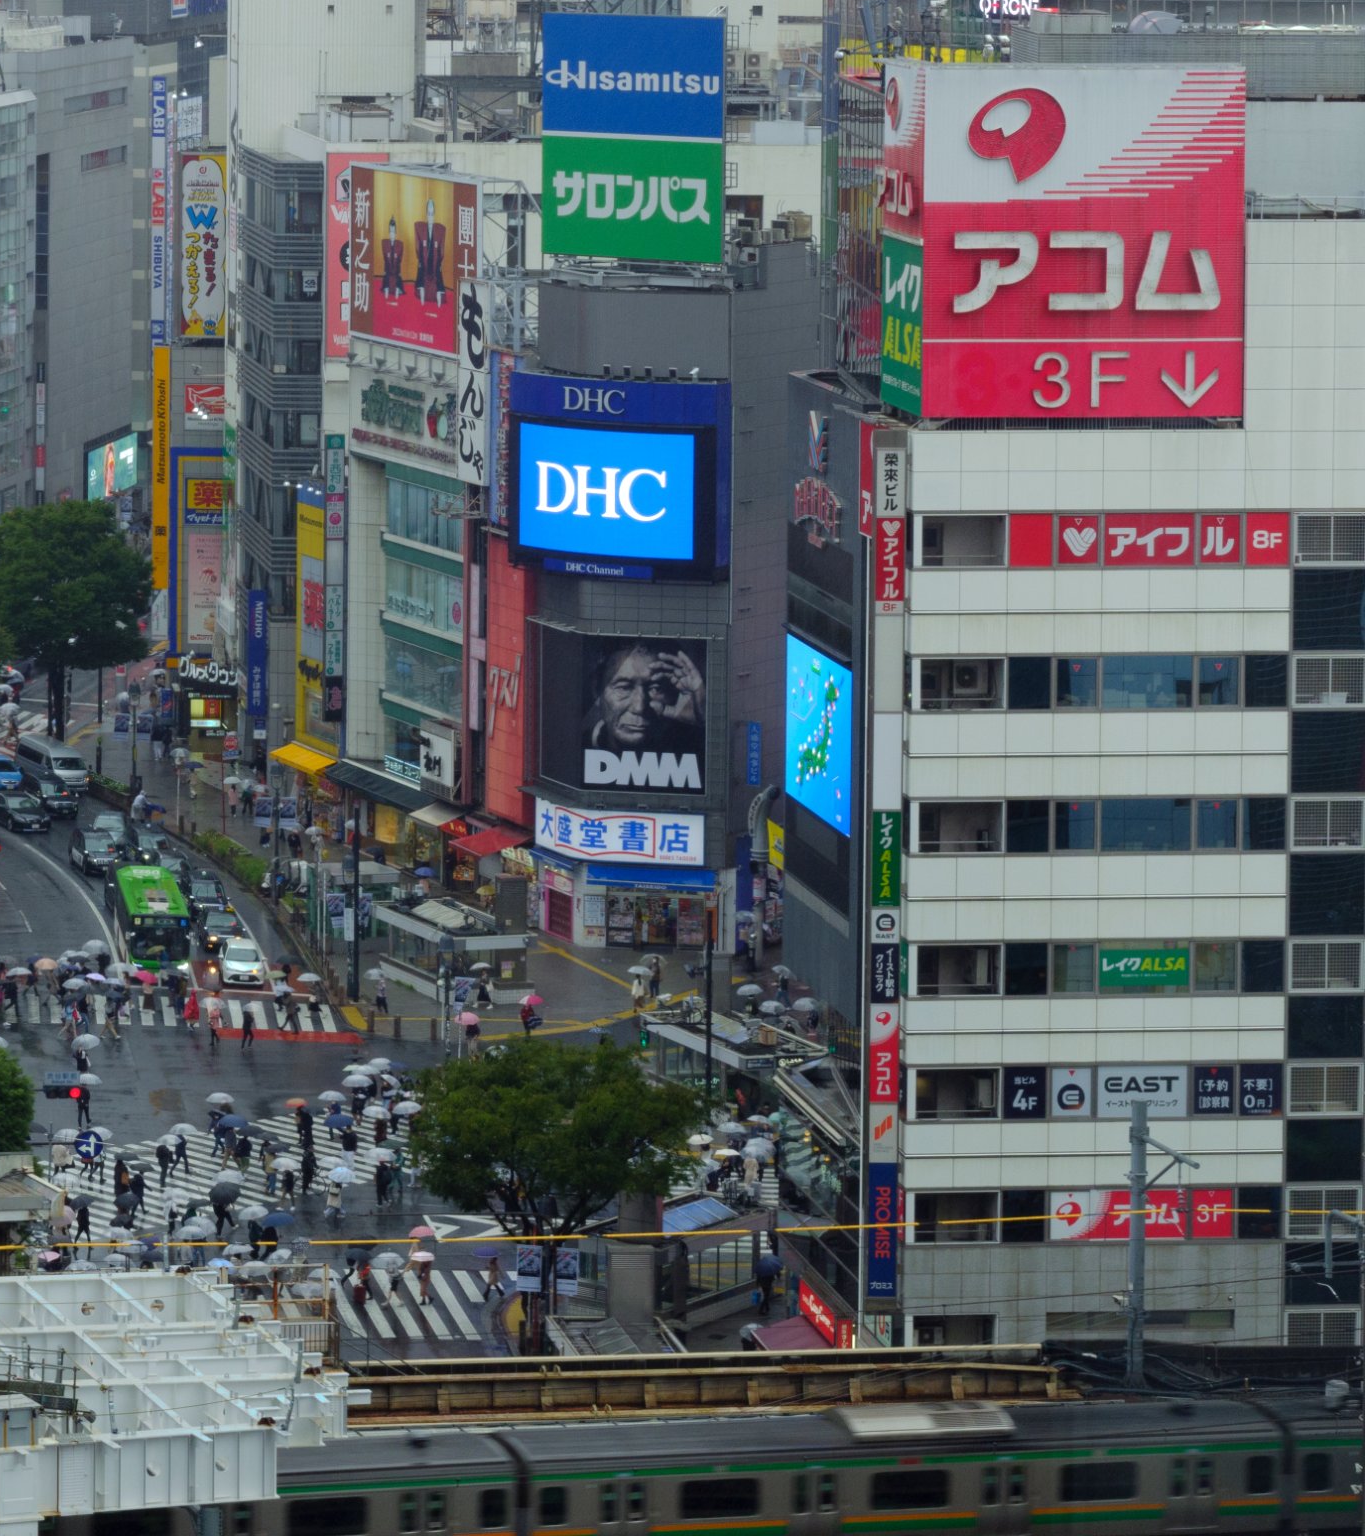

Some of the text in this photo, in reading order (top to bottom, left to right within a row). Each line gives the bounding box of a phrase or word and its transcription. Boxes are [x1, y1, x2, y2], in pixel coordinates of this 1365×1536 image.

[545, 61, 720, 97] Hisamitsu
[153, 96, 166, 134] LABI
[152, 181, 165, 225] LABI
[552, 170, 711, 224] サロンパス
[153, 236, 163, 289] SHIBUYA
[354, 187, 371, 313] 新之助
[953, 230, 1222, 314] アコム
[885, 256, 922, 312] レイク
[883, 316, 922, 370] ALSA
[459, 282, 485, 481] もんじゃ
[563, 386, 626, 415] DHC
[1033, 351, 1130, 409] 3F
[157, 421, 167, 485] Matsumoto
[535, 460, 667, 522] DHC
[1109, 527, 1283, 557] アイフル 8F
[566, 562, 624, 576] DHC Channel
[883, 538, 899, 599] アイフル
[881, 603, 897, 612] 8F
[584, 748, 702, 789] DMM
[541, 808, 690, 853] 大盛堂書店
[879, 813, 893, 849] レイク
[880, 849, 892, 898] ALSA
[1102, 955, 1186, 973] レイクALSA
[876, 1051, 891, 1096] アコム
[1014, 1076, 1036, 1085] 当ビル
[1104, 1076, 1179, 1093] EAST
[1013, 1089, 1038, 1111] 4F
[875, 1186, 890, 1259] PROMISE
[1196, 1204, 1226, 1223] 3F
[870, 1281, 894, 1289] プロミス
